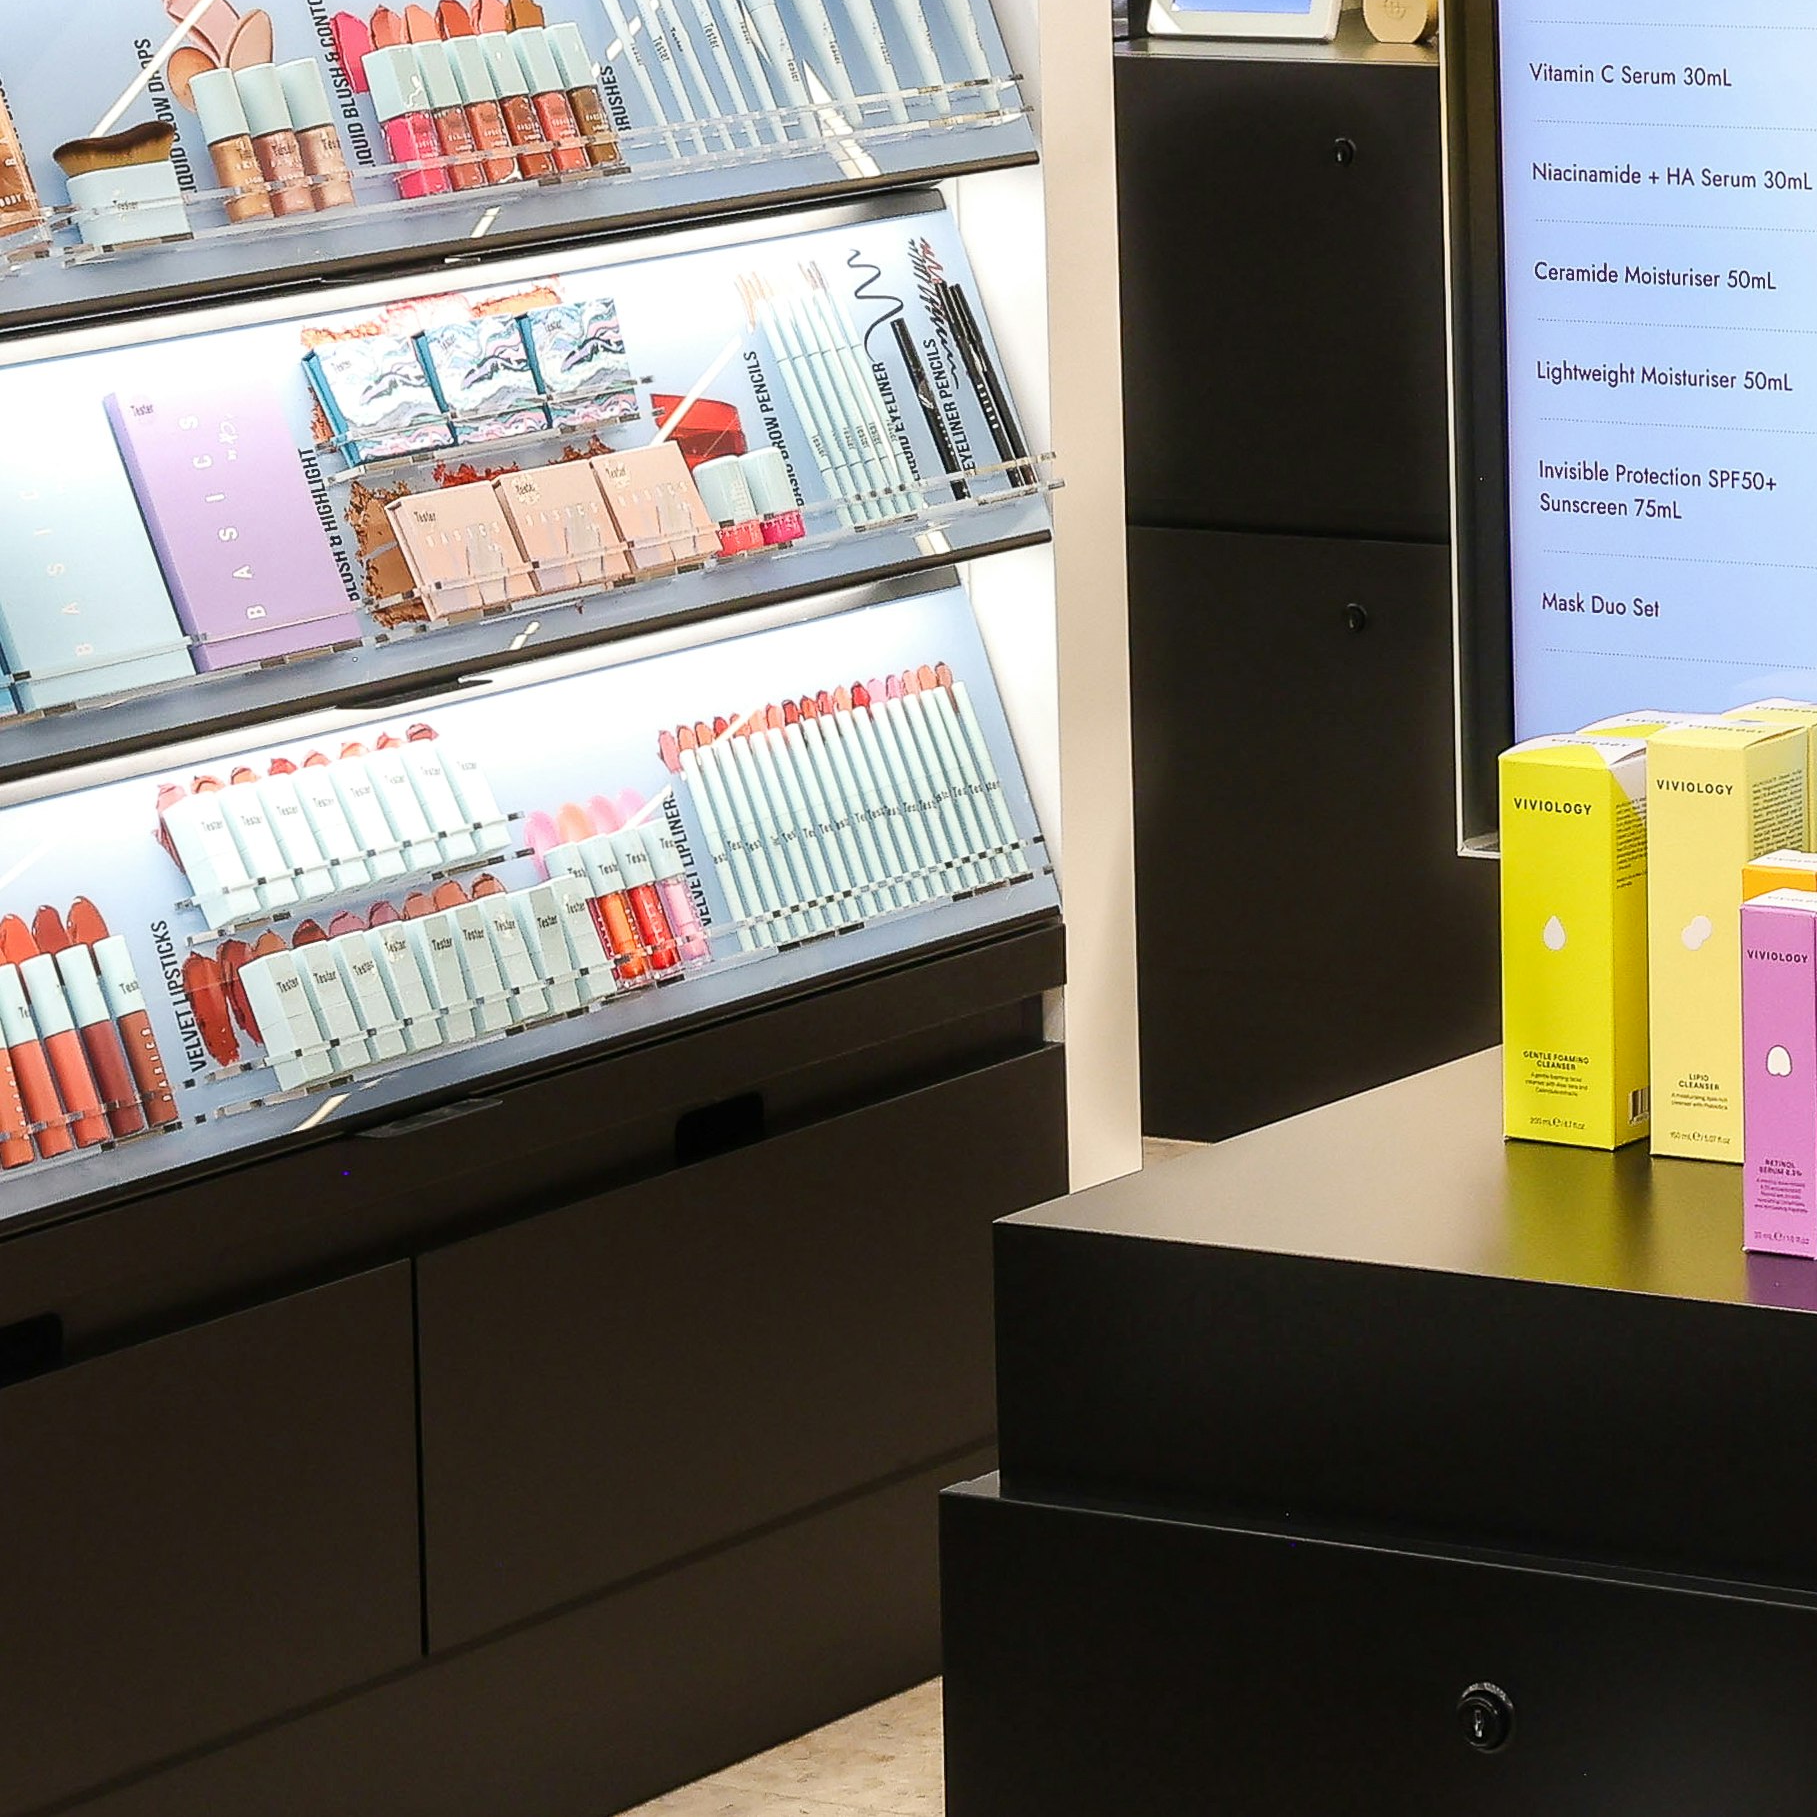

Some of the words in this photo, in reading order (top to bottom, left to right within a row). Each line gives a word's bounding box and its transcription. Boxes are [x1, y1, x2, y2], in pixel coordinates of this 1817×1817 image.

[1529, 63, 1595, 84] Vitamin
[1601, 65, 1615, 84] C
[1621, 66, 1677, 86] Serum
[1683, 67, 1732, 87] 30mL
[332, 68, 362, 119] BLUSH
[1532, 162, 1641, 186] Niacinamide
[1648, 172, 1660, 184] +
[1667, 168, 1694, 187] HA
[1700, 169, 1757, 189] Serum
[1764, 171, 1813, 191] 30mL
[1534, 261, 1619, 284] Ceramide
[1625, 264, 1720, 287] Moisturiser
[1727, 270, 1776, 291] 50mL
[923, 338, 951, 397] PENCILS
[1536, 361, 1636, 388] Lightweight
[1641, 366, 1737, 389] Moisturiser
[1743, 371, 1793, 392] 50mL
[743, 350, 775, 413] PENCILS
[130, 402, 155, 418] Tester
[939, 397, 976, 472] EYELINER
[1539, 460, 1609, 484] Invisible
[1615, 463, 1702, 486] Protection
[1708, 470, 1777, 491] SPF50+
[298, 448, 340, 532] HIGHLIGHT
[1540, 494, 1628, 517] Sunscreen
[1634, 500, 1682, 520] 75mL
[335, 544, 361, 602] BLUSH
[1542, 592, 1586, 614] Mask
[1592, 596, 1627, 617] Duo
[1633, 598, 1660, 618] Set
[1656, 778, 1734, 797] VIVIOLOGY
[1514, 797, 1593, 817] VIVIOLOGY
[462, 925, 485, 943] Tester
[536, 914, 559, 931] Tester
[431, 935, 453, 953] Tester
[1747, 949, 1809, 965] VIVIOLOGY
[153, 919, 186, 1006] LIPSTICKS
[313, 968, 337, 986] Tester
[176, 1005, 207, 1072] VELVET
[1523, 1050, 1551, 1060] GENTLE
[1537, 1060, 1576, 1071] CLEANSER
[1678, 1081, 1720, 1091] CLEANSER
